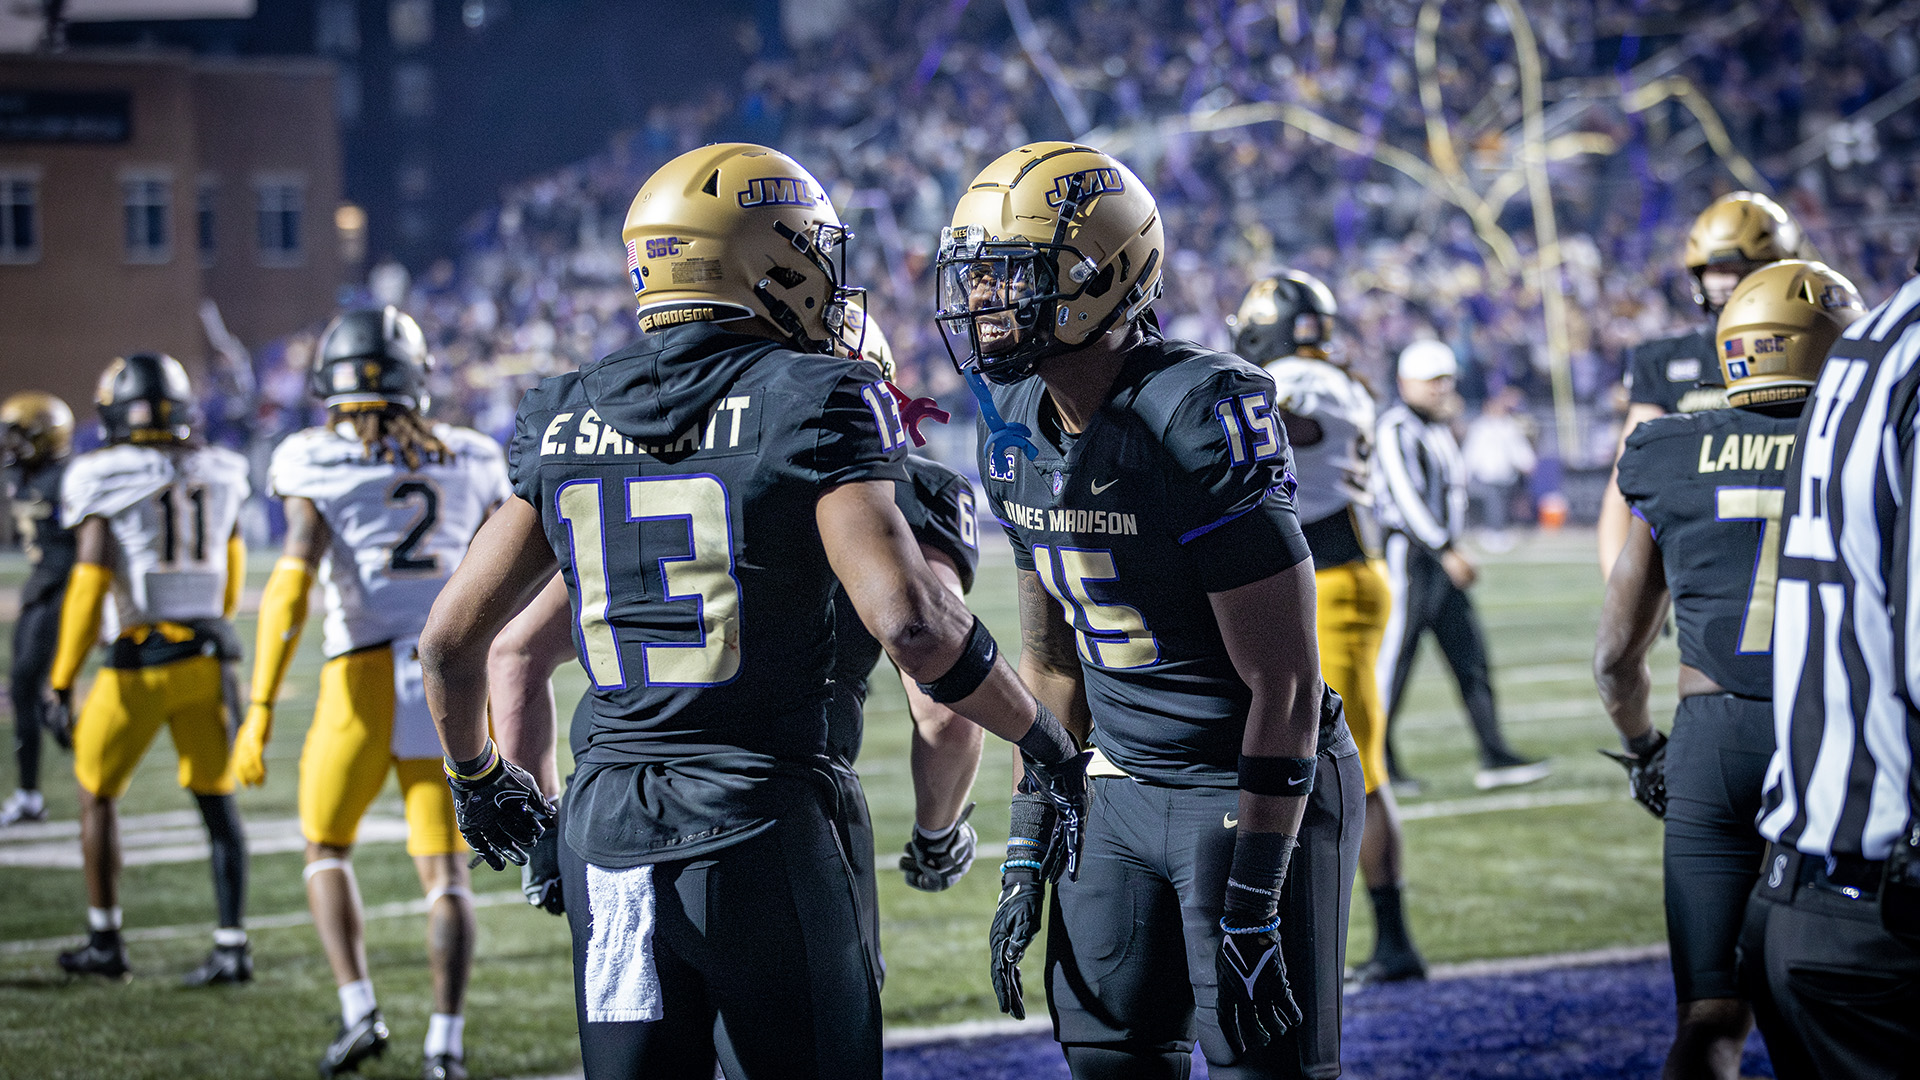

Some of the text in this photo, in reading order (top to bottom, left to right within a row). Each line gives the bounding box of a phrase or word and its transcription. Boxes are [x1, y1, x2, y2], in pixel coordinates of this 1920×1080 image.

[646, 236, 679, 259] SBC
[540, 396, 750, 456] E. SAATT
[860, 379, 907, 453] 13
[1215, 391, 1280, 467] 15
[1698, 433, 1798, 474] LAWT
[156, 485, 209, 567] 11
[388, 477, 441, 575] 2
[1048, 509, 1138, 535] MADISON
[555, 472, 743, 691] 13
[1032, 543, 1161, 669] 15
[1715, 485, 1786, 656] 7
